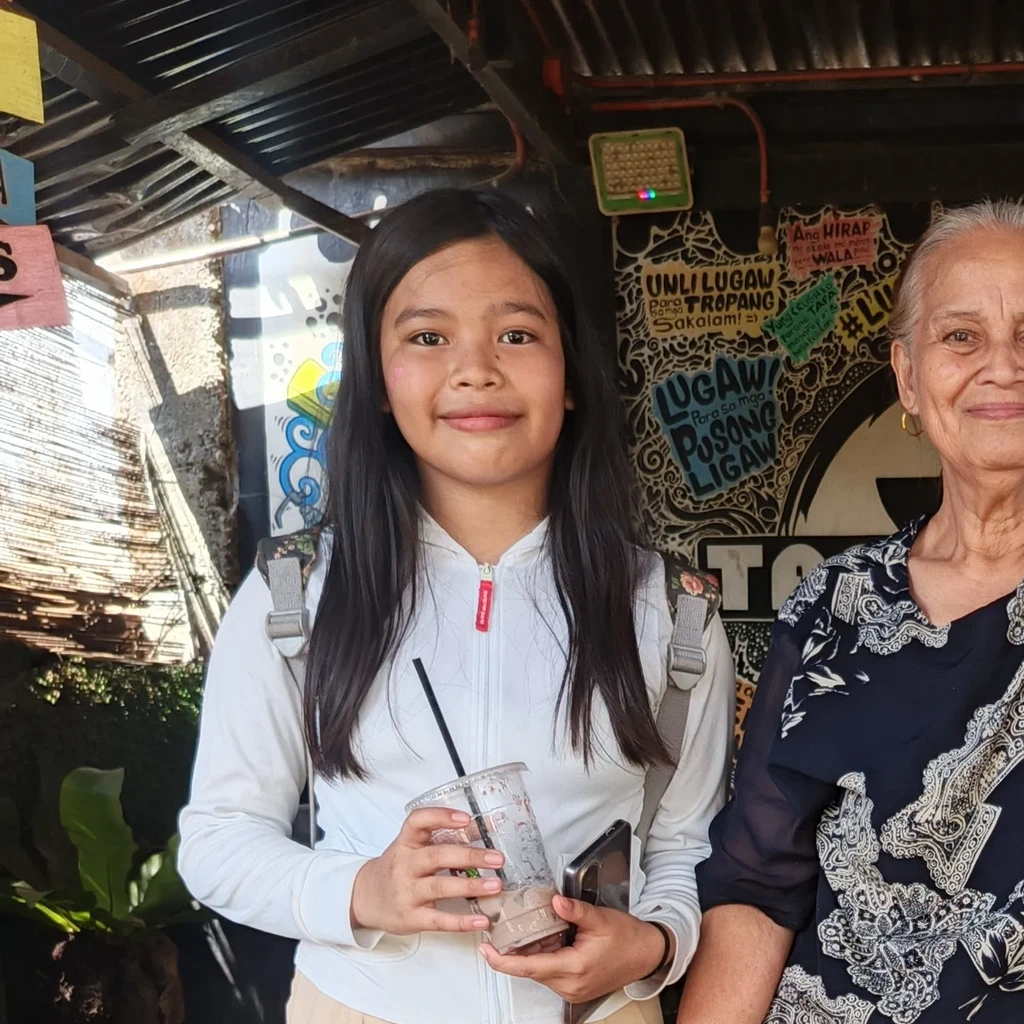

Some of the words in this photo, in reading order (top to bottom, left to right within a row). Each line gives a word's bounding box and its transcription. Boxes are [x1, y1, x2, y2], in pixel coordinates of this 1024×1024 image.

[793, 225, 820, 244] Ang
[823, 221, 871, 240] HIRAP
[812, 249, 853, 266] WALA
[646, 272, 697, 298] UNLI
[702, 268, 775, 293] LUGAW
[683, 291, 775, 314] TROPANG
[653, 312, 742, 333] Sakalam!
[655, 357, 781, 426] LUGAW!
[670, 401, 777, 472] PUSONG
[689, 434, 777, 499] LIGAW
